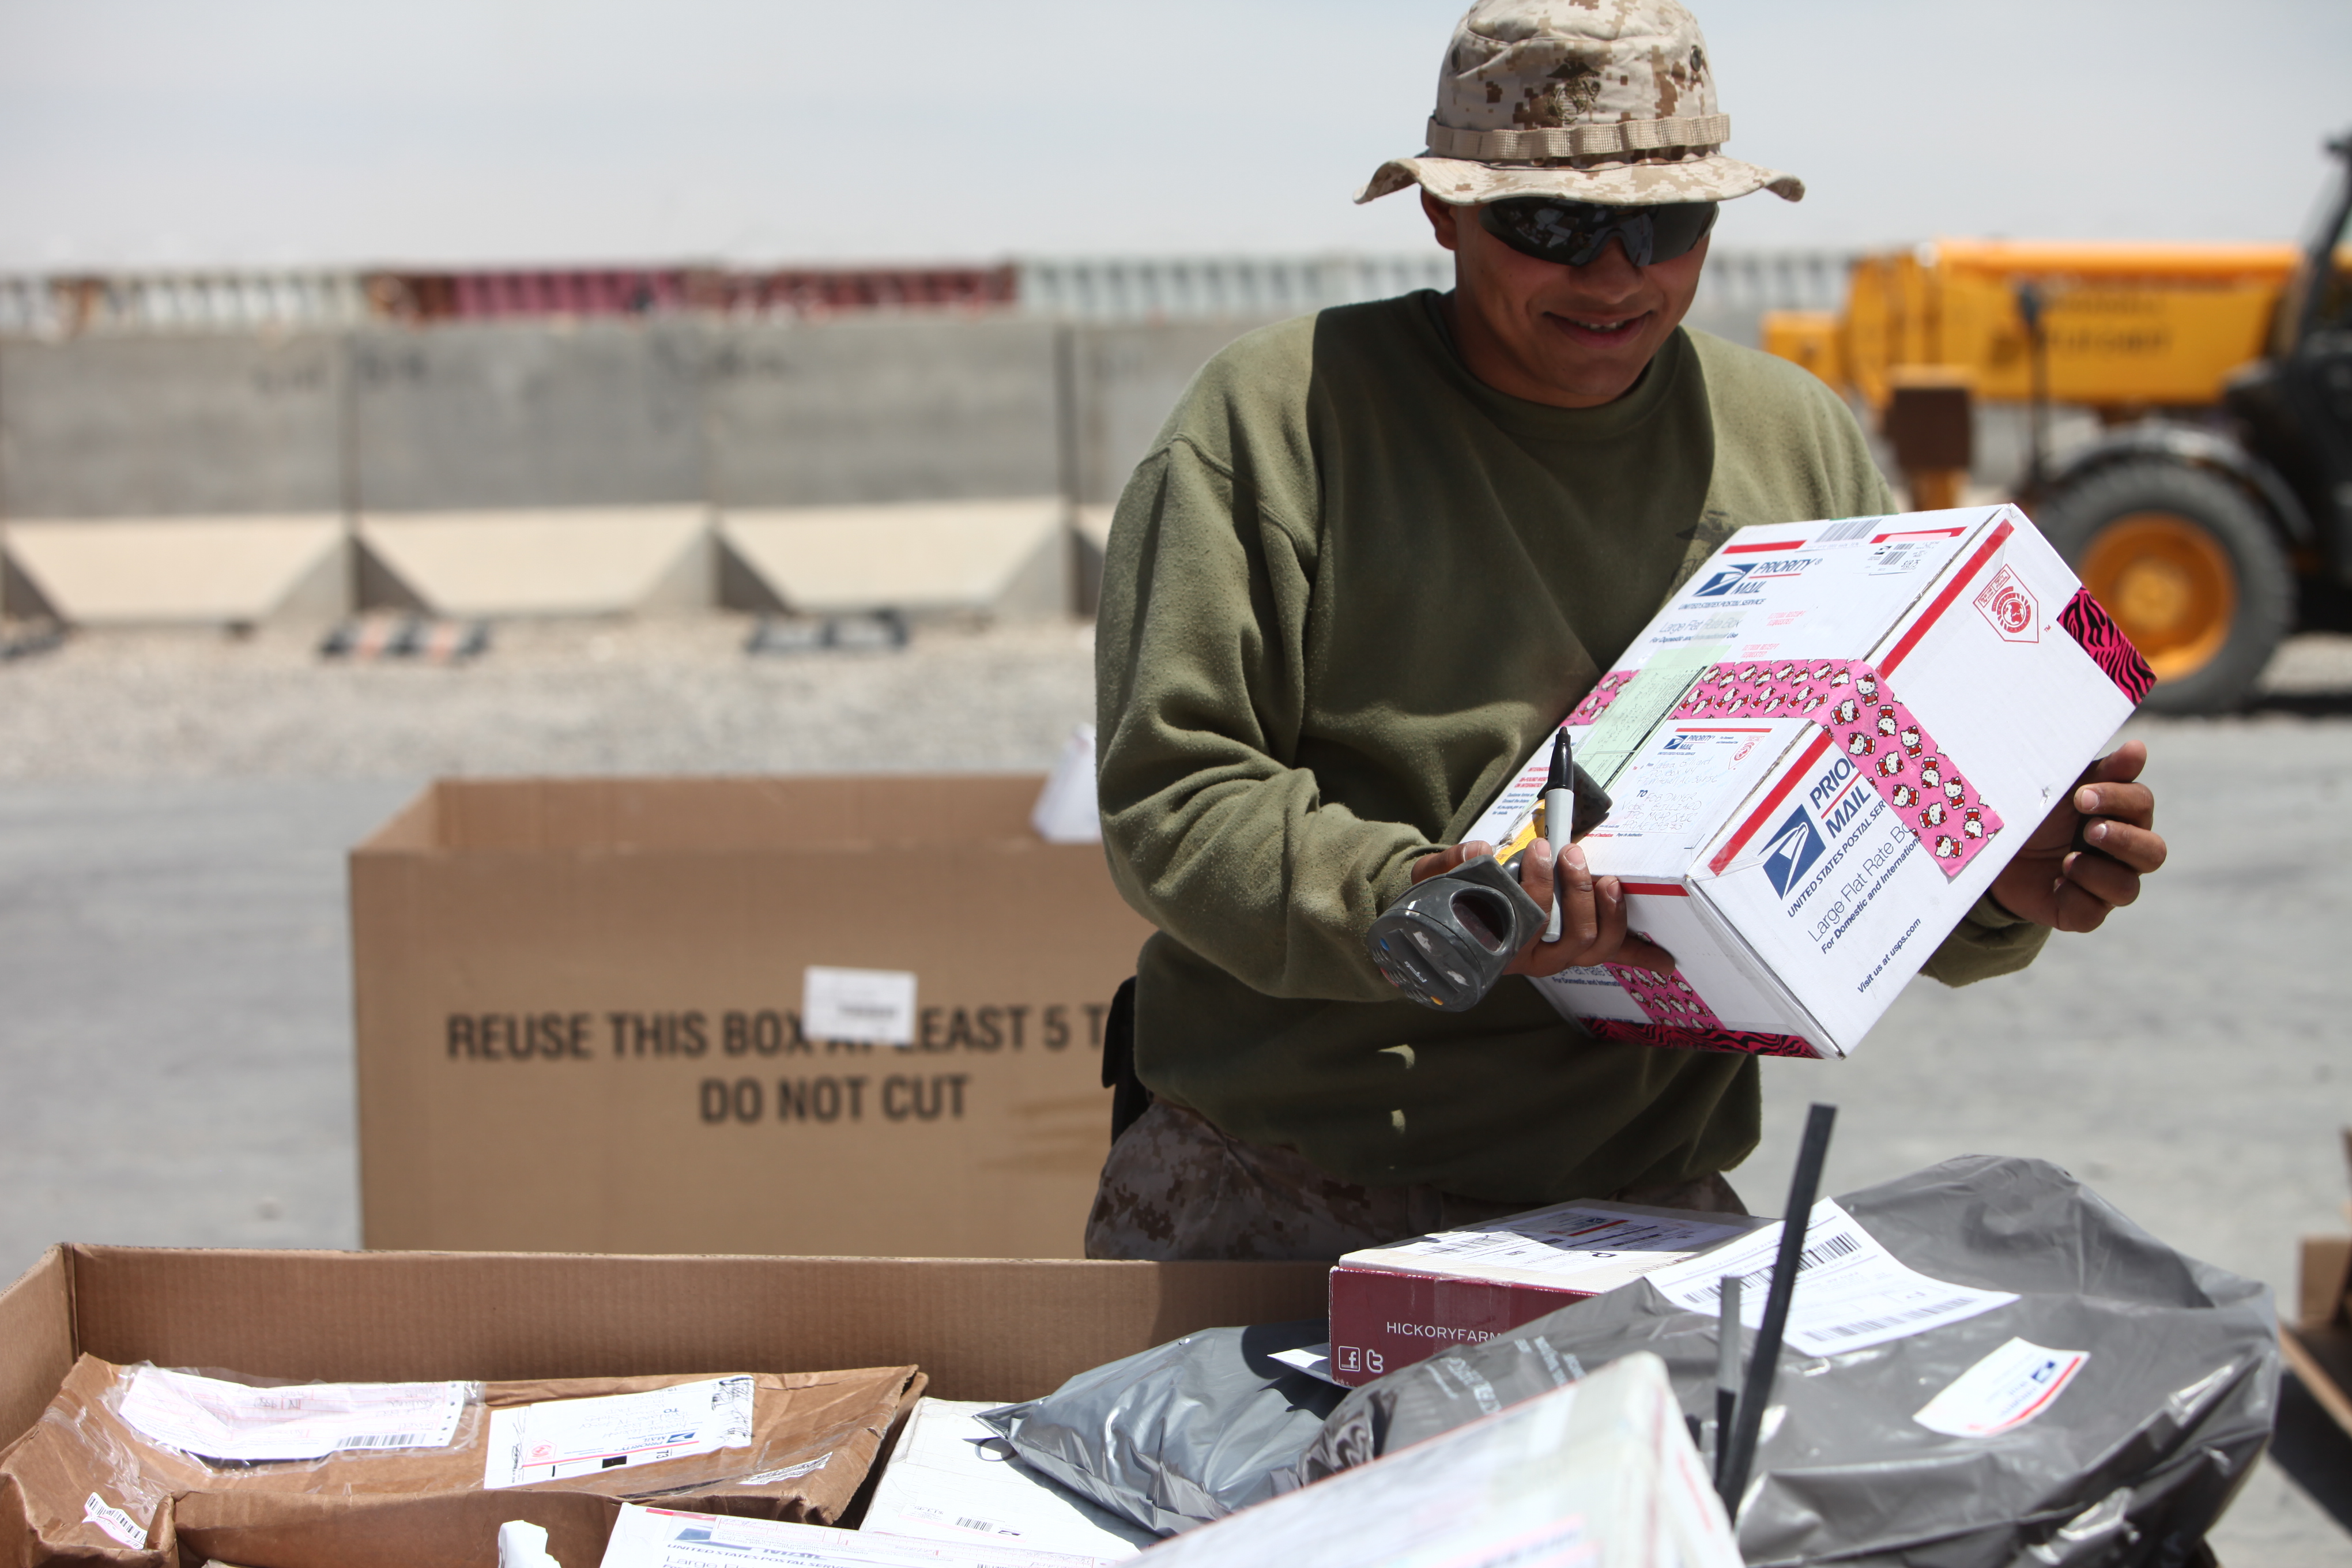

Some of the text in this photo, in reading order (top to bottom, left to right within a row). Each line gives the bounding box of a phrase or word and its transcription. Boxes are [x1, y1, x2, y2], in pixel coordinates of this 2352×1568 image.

[1730, 581, 1767, 595] MAIL
[1659, 622, 1686, 634] Large
[1810, 757, 1856, 811] PRIO
[1825, 785, 1871, 839] MAIL
[1787, 800, 1886, 918] UNITED STATES POSTAL SER
[1807, 823, 1912, 942] Large Flat Rate Bo
[1820, 838, 1919, 954] For Domestic and Internation
[1857, 917, 1921, 993] Visit us at usps.com
[447, 1008, 594, 1061] REUSE
[603, 1007, 709, 1060] THIS
[721, 1006, 812, 1058] BOX
[895, 1004, 1032, 1055] EAST
[1043, 1004, 1071, 1051] 5
[1081, 1004, 1107, 1050] T
[699, 1073, 973, 1125] DO NOT CUT
[621, 1441, 663, 1451] PRIORITY
[667, 1544, 715, 1554] UNITED
[715, 1551, 760, 1559] STATES
[760, 1556, 808, 1565] POSTAL
